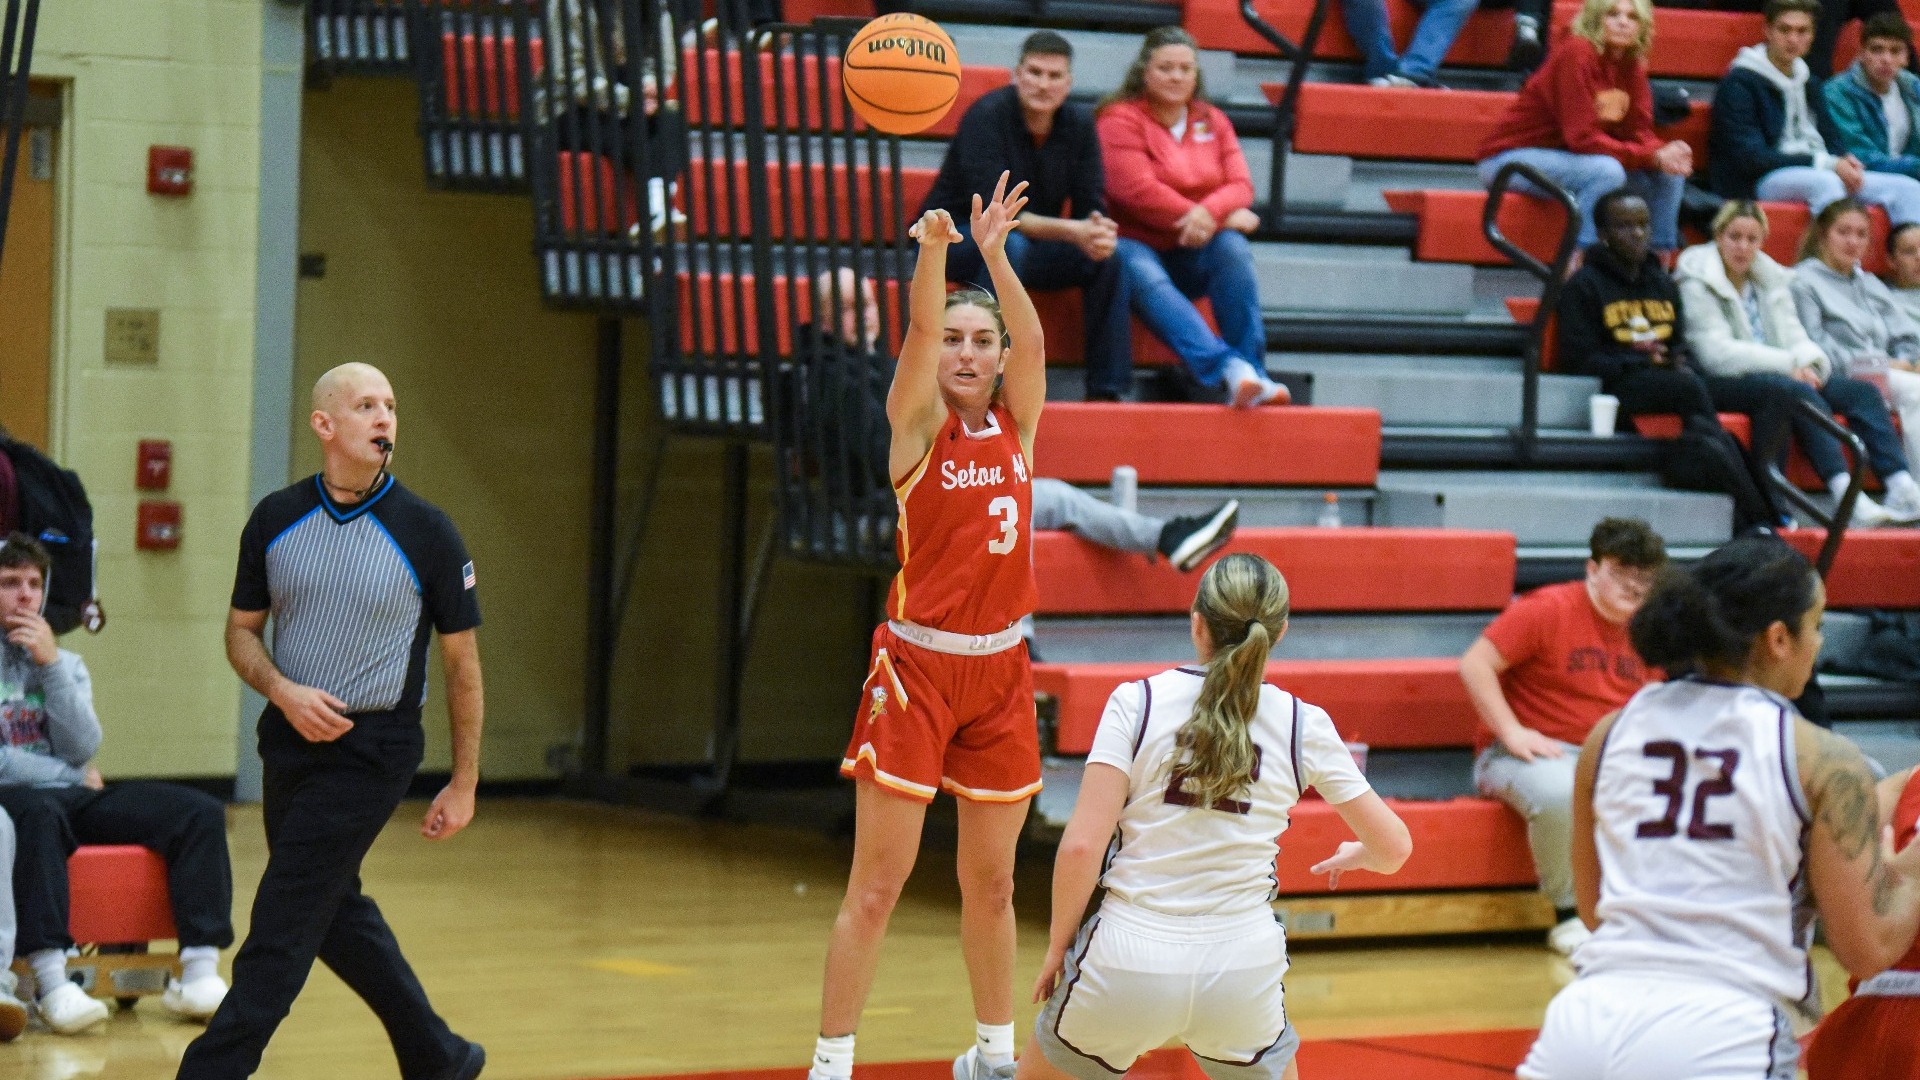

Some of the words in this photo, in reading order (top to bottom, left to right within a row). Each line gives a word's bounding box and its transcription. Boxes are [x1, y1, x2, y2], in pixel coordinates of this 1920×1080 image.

[868, 36, 946, 65] Wilson
[941, 460, 1005, 490] Seton
[988, 495, 1018, 555] 3
[1636, 740, 1740, 840] 32
